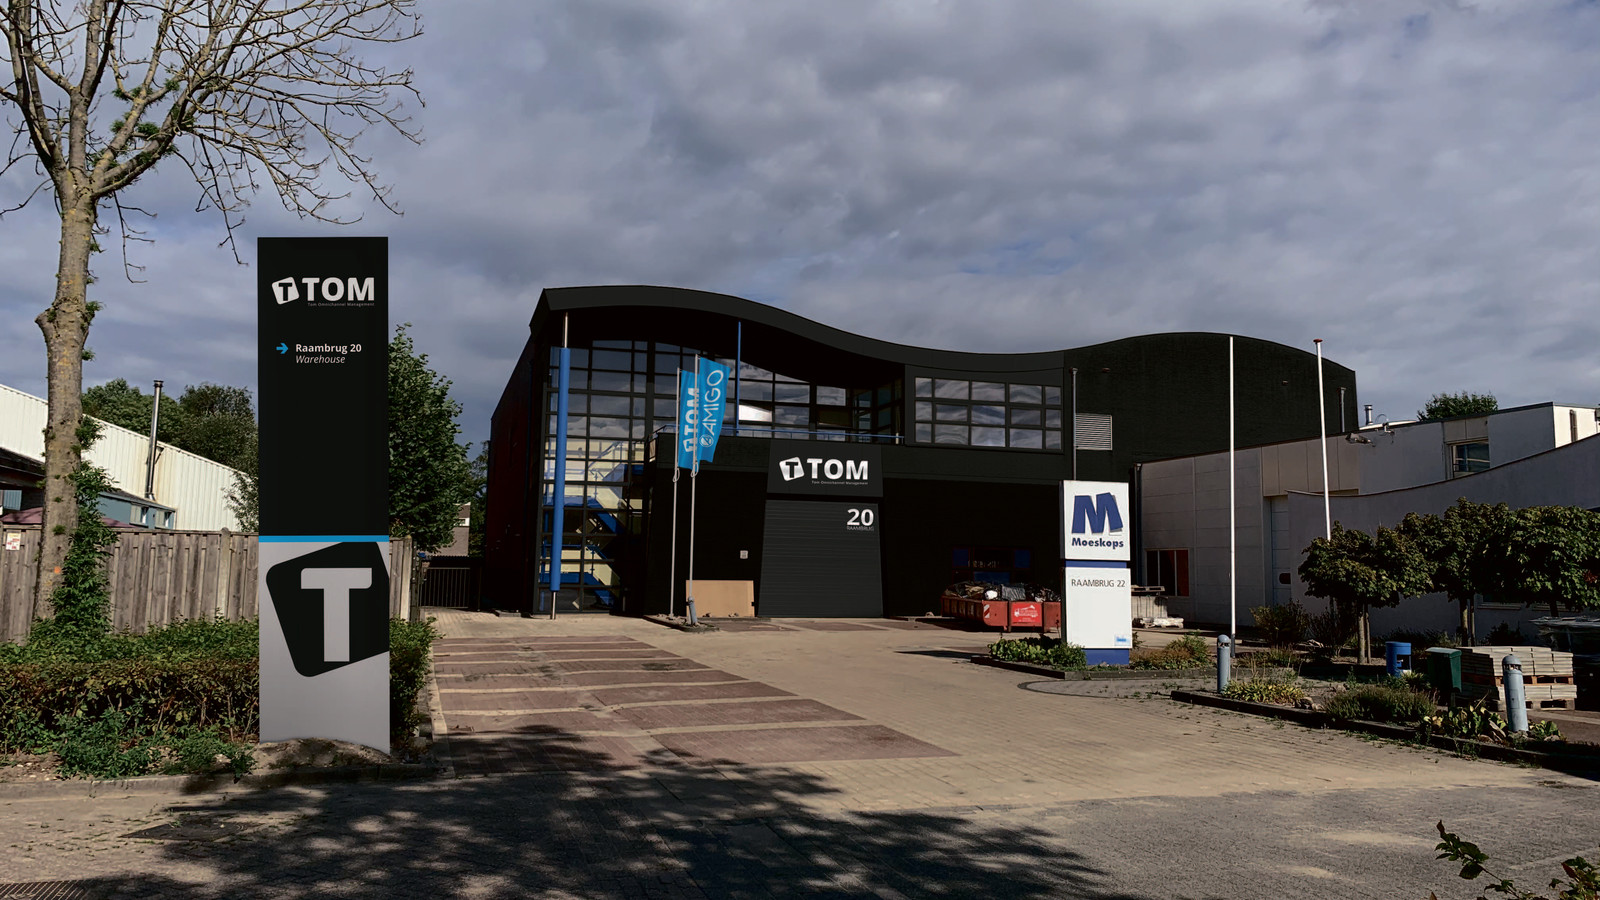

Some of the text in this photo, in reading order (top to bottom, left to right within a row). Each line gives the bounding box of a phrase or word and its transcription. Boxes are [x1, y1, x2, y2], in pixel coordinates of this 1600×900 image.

[301, 276, 375, 302] TOM
[295, 343, 362, 355] Raambrug 20
[295, 354, 346, 364] Warehouse
[702, 369, 724, 436] AMIGO
[806, 458, 869, 481] TOM
[846, 508, 875, 527] 20
[1071, 537, 1124, 550] Moeskops
[1071, 579, 1126, 588] RAAMBRUG 22
